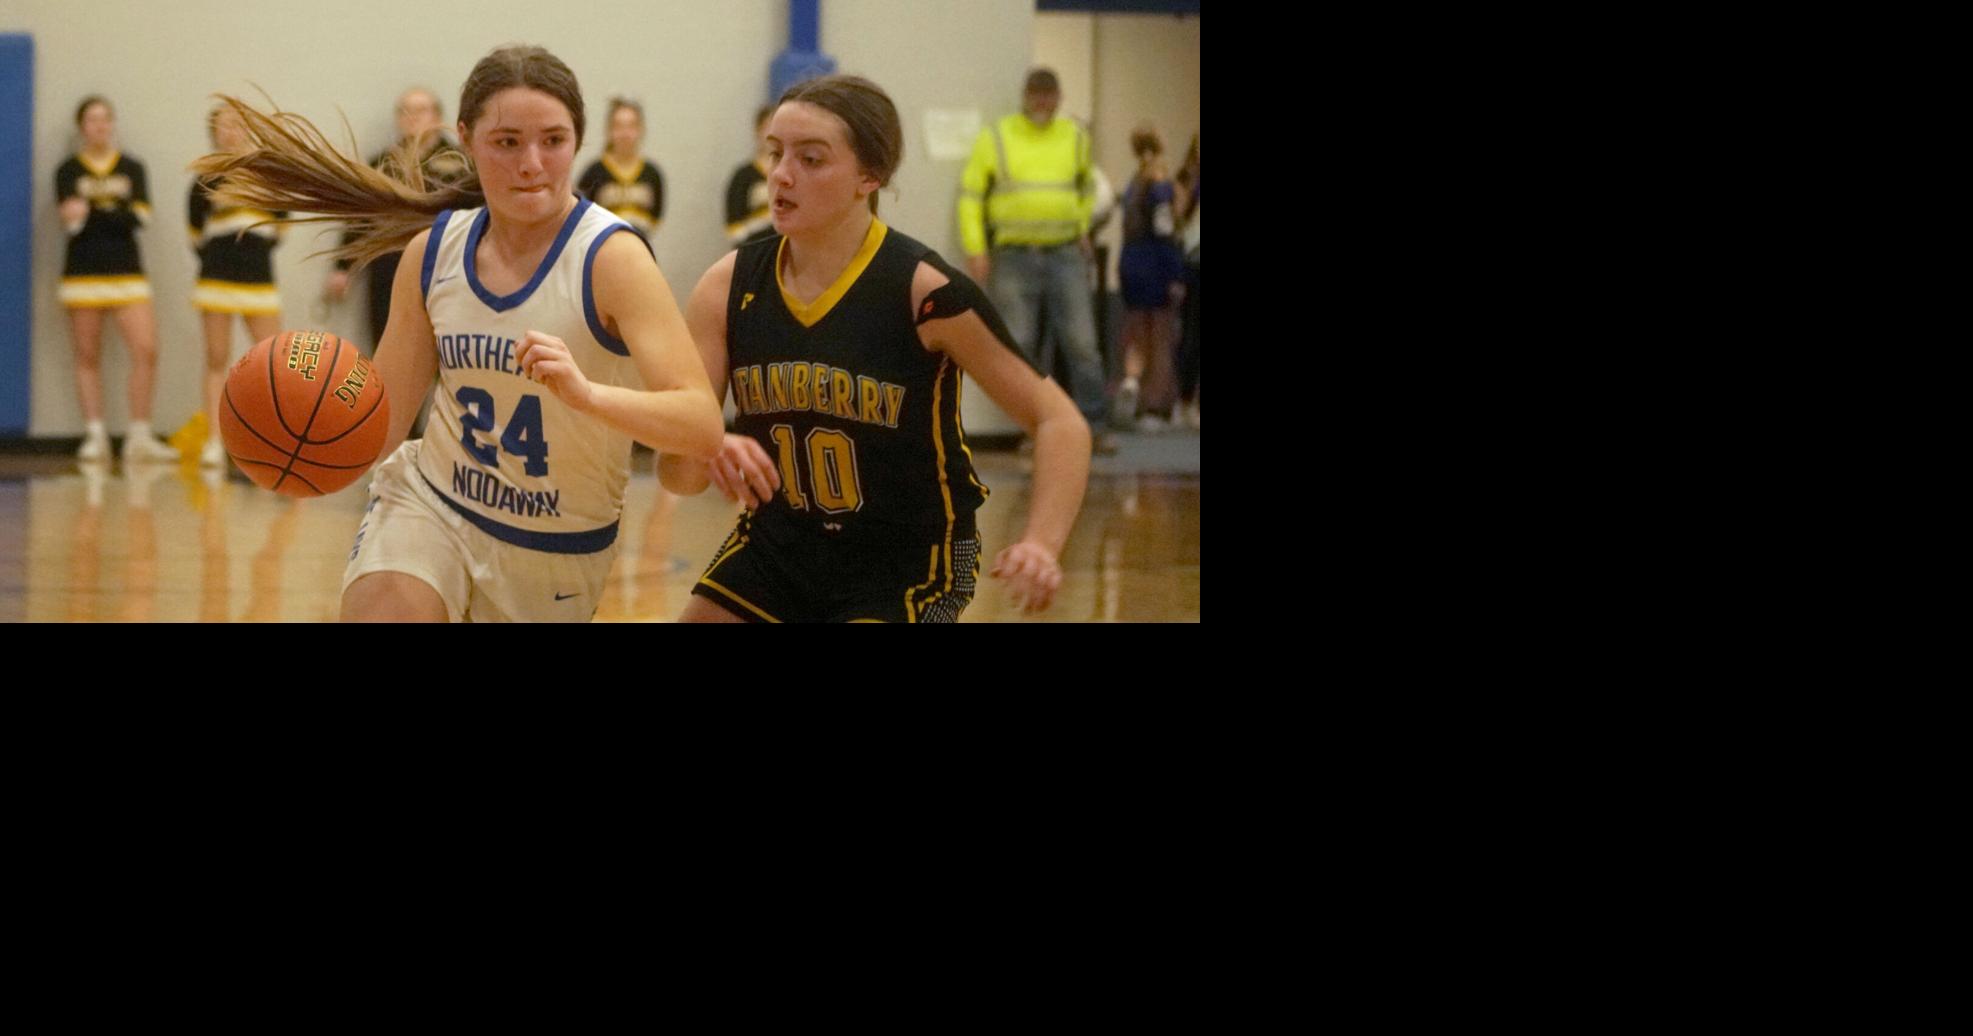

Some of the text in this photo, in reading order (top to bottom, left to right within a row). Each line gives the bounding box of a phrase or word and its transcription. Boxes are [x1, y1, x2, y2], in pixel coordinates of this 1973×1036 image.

[334, 352, 370, 410] DING
[437, 334, 524, 376] ORTHE
[734, 361, 906, 428] TANBERRY
[456, 386, 549, 478] 24
[453, 461, 561, 517] NODAWAY
[770, 424, 864, 514] 10
